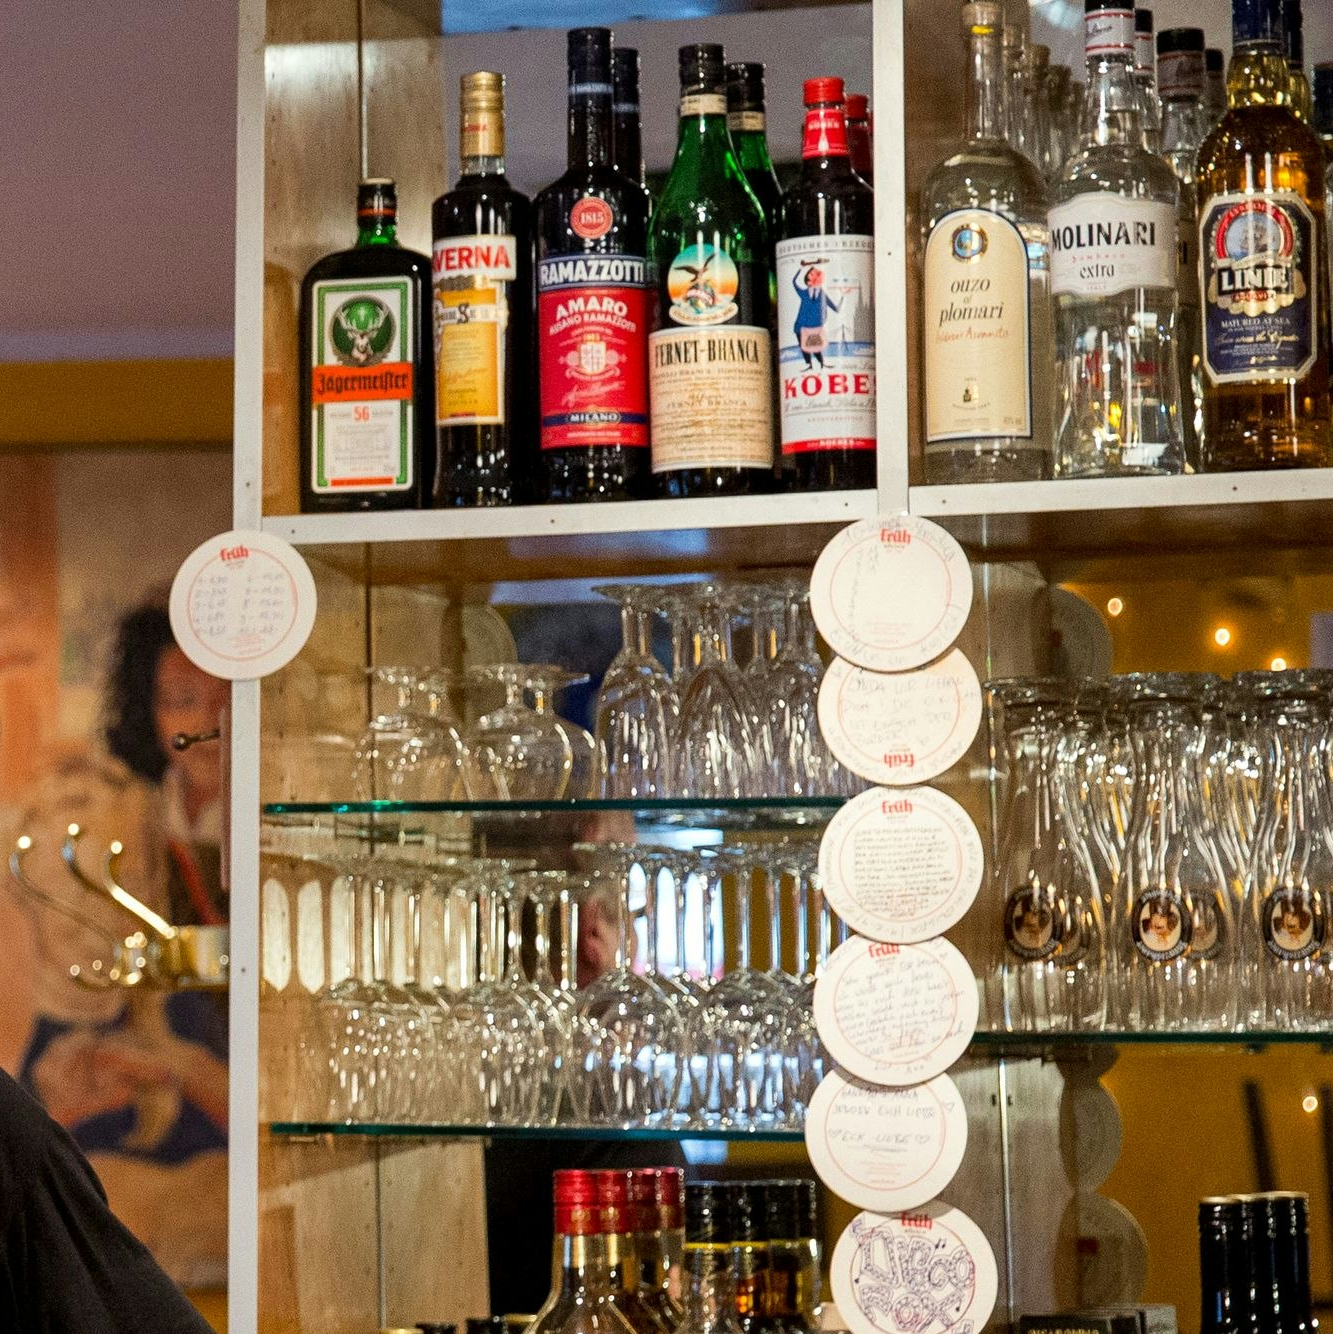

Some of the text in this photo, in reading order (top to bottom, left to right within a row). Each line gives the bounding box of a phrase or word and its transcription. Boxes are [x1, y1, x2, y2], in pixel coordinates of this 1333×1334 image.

[1051, 222, 1156, 252] MOLINARI
[540, 259, 645, 285] RAMAZZOTTI
[1079, 263, 1115, 279] extra
[1220, 268, 1289, 291] LINIE
[950, 277, 991, 294] ouzo
[555, 295, 628, 320] AMARO
[938, 302, 1005, 327] plomari
[784, 371, 876, 399] KÖBE
[353, 406, 371, 422] 56
[879, 527, 912, 545] früh
[219, 545, 250, 562] früh
[881, 799, 914, 815] früh
